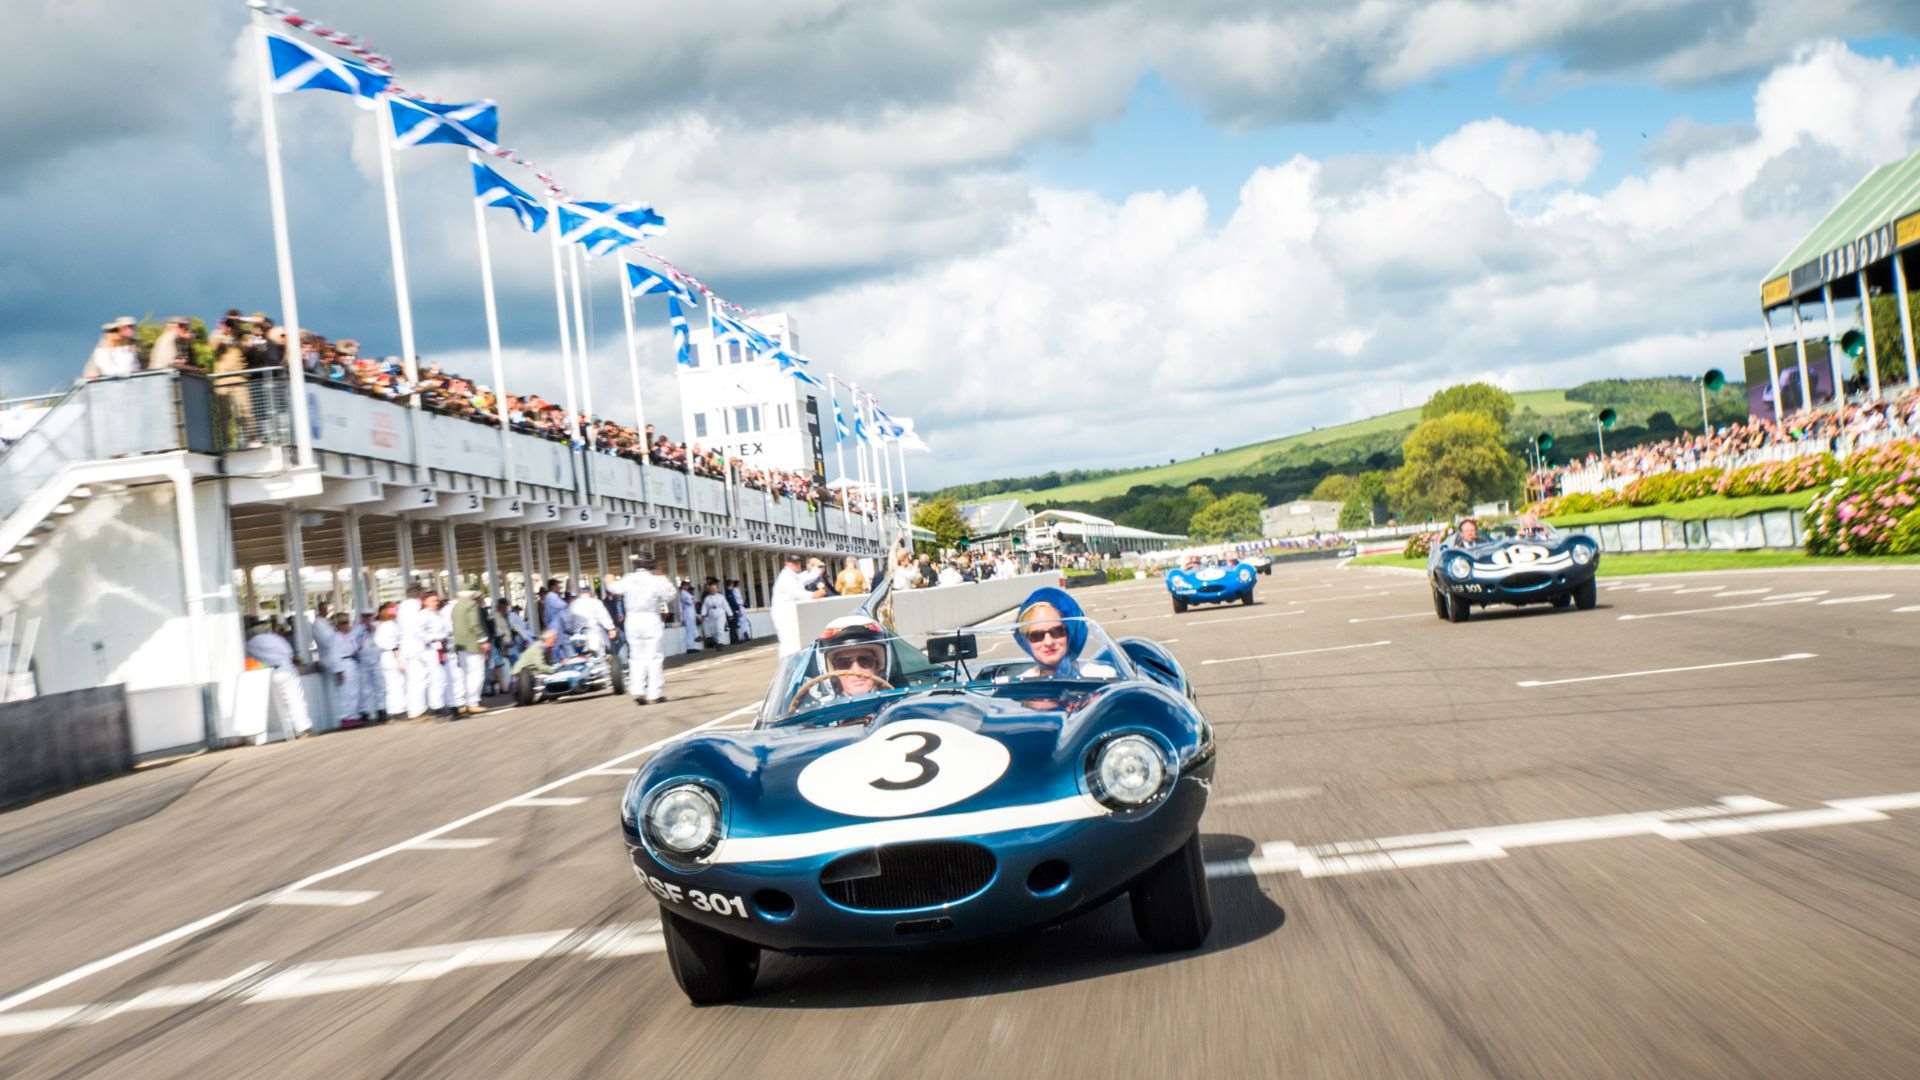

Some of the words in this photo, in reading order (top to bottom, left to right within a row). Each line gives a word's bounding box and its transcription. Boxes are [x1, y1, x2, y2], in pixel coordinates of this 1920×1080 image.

[420, 487, 432, 503] 2
[467, 494, 479, 509] 3
[509, 500, 519, 512] 4
[547, 505, 556, 518] 5
[580, 509, 589, 521] 6
[623, 515, 631, 526] 7
[649, 518, 657, 529] 8
[673, 521, 681, 531] 9
[688, 524, 701, 535] 10
[711, 527, 721, 537] 11
[727, 529, 738, 539] 12
[868, 730, 943, 791] 3
[633, 863, 684, 904] RSF
[688, 889, 749, 918] 301
